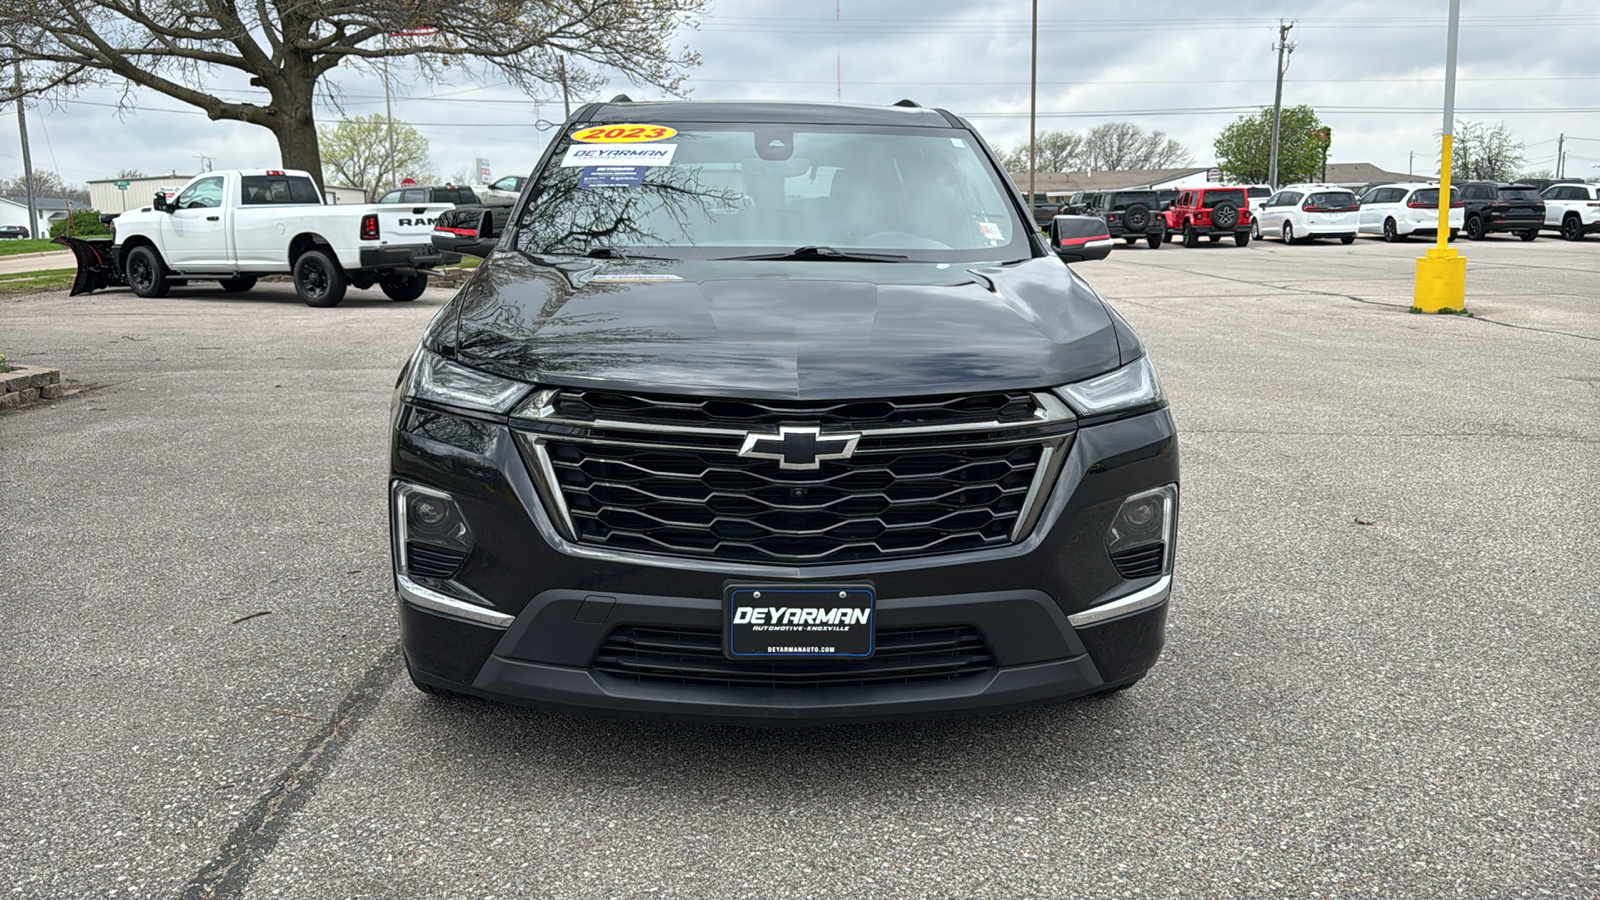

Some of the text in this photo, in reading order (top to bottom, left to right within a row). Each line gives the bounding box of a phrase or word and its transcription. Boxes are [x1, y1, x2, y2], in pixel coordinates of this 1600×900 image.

[581, 128, 667, 140] 2023
[398, 218, 438, 226] RAM
[733, 607, 871, 624] DEYARMAN
